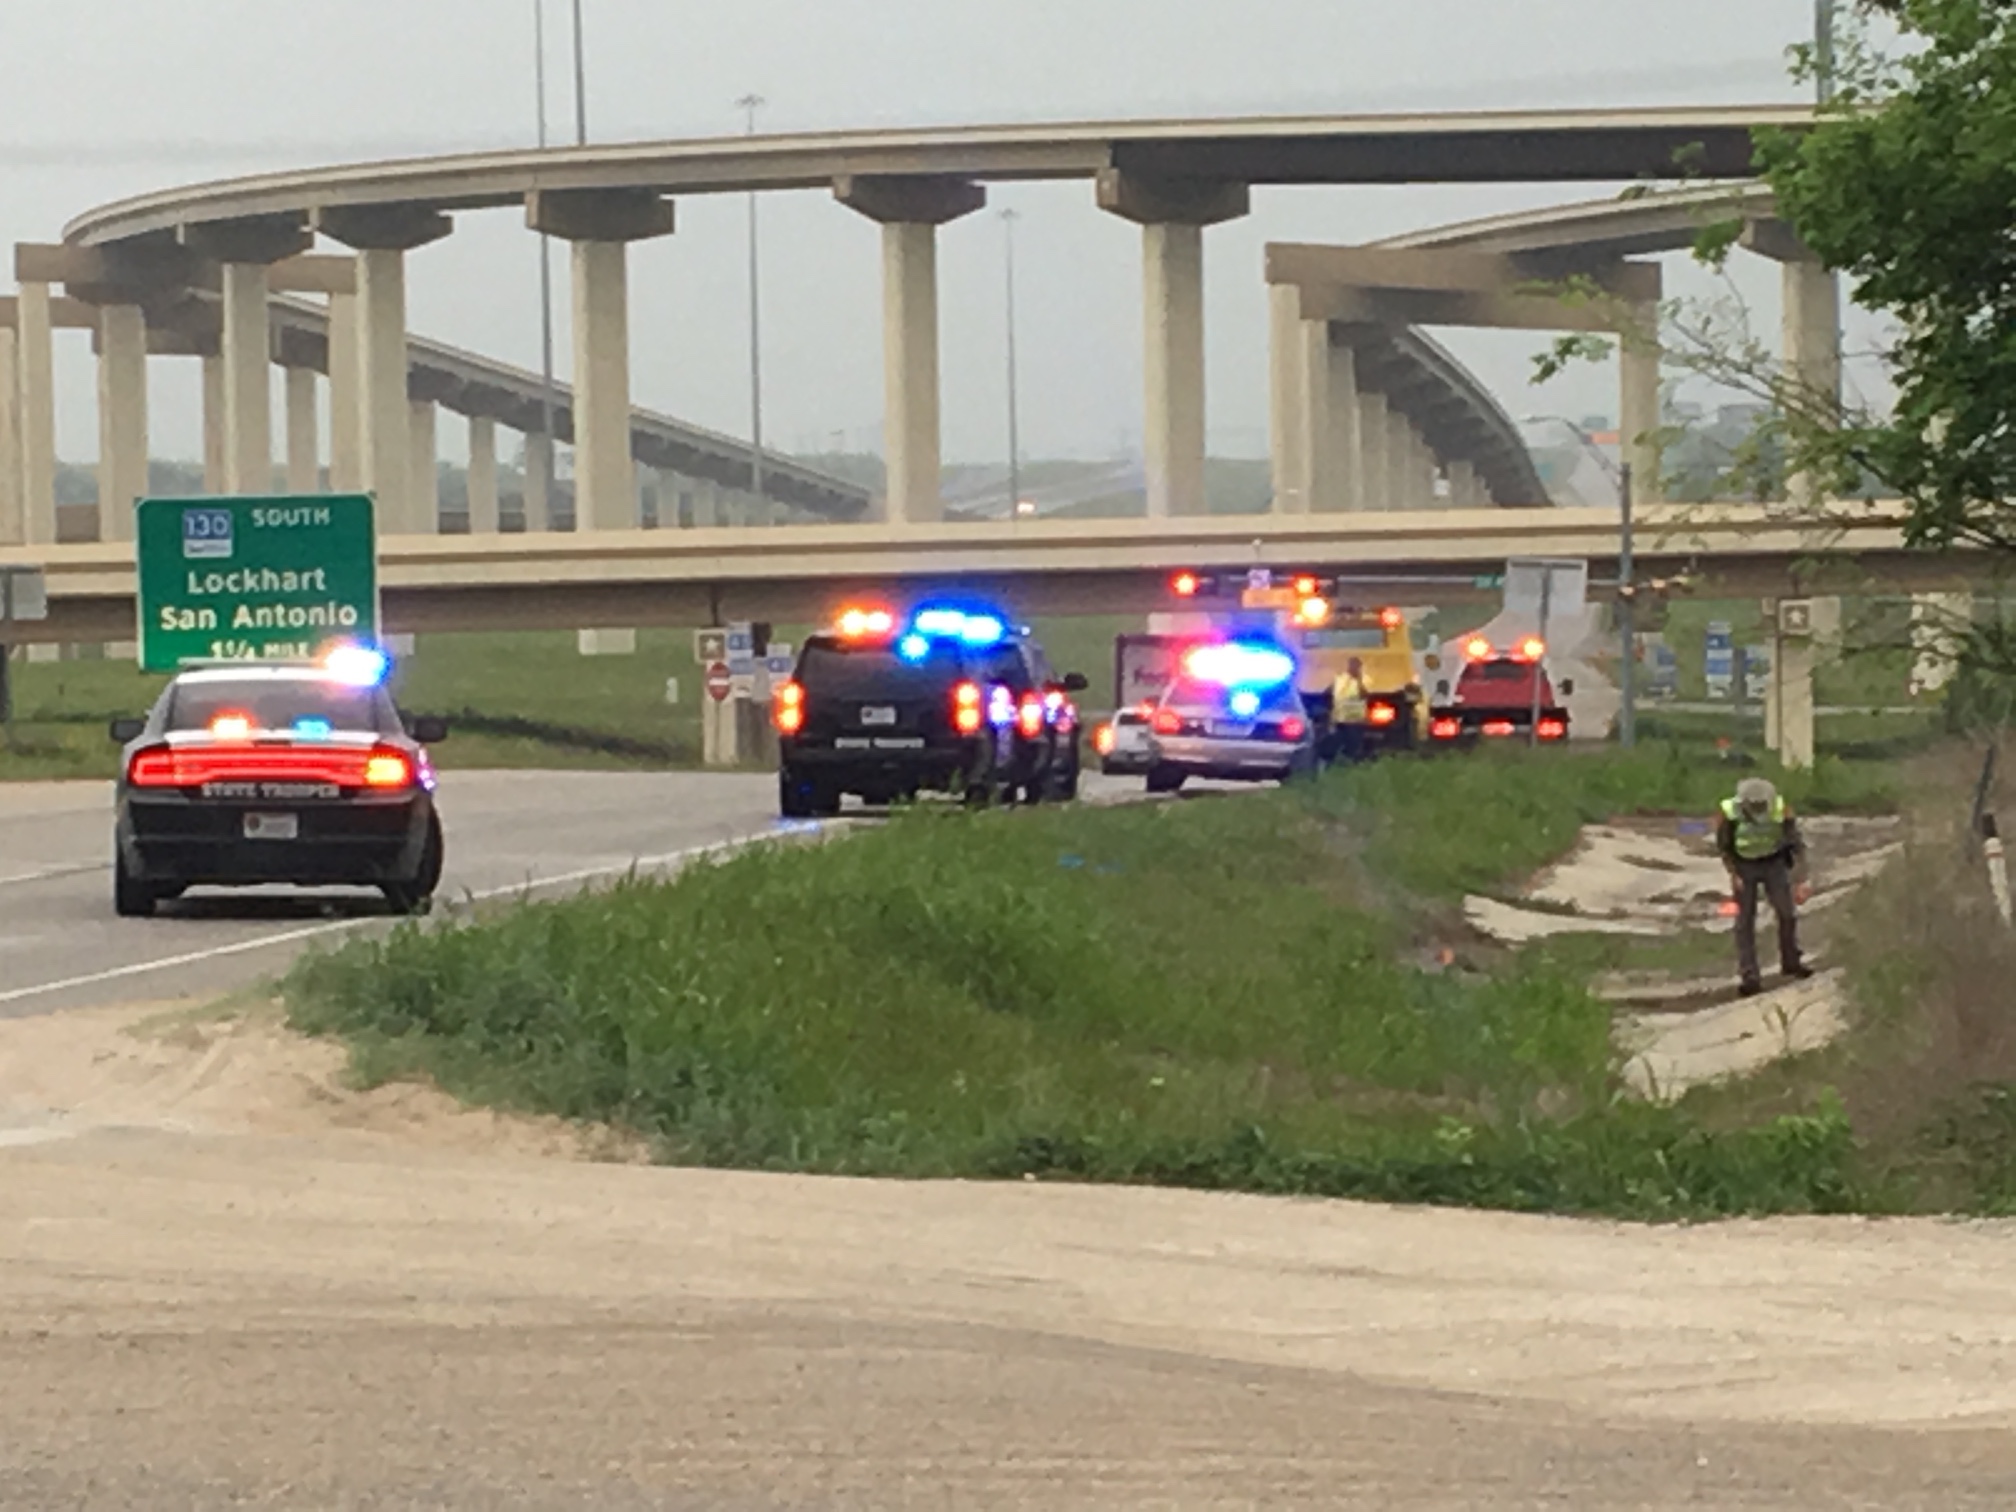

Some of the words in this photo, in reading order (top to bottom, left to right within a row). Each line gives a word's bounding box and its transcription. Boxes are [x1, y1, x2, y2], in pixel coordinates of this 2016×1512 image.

[188, 515, 229, 536] 130
[252, 507, 330, 527] SOUTH
[188, 568, 326, 594] Lockhart
[161, 606, 217, 630] San
[232, 601, 358, 629] Antonio
